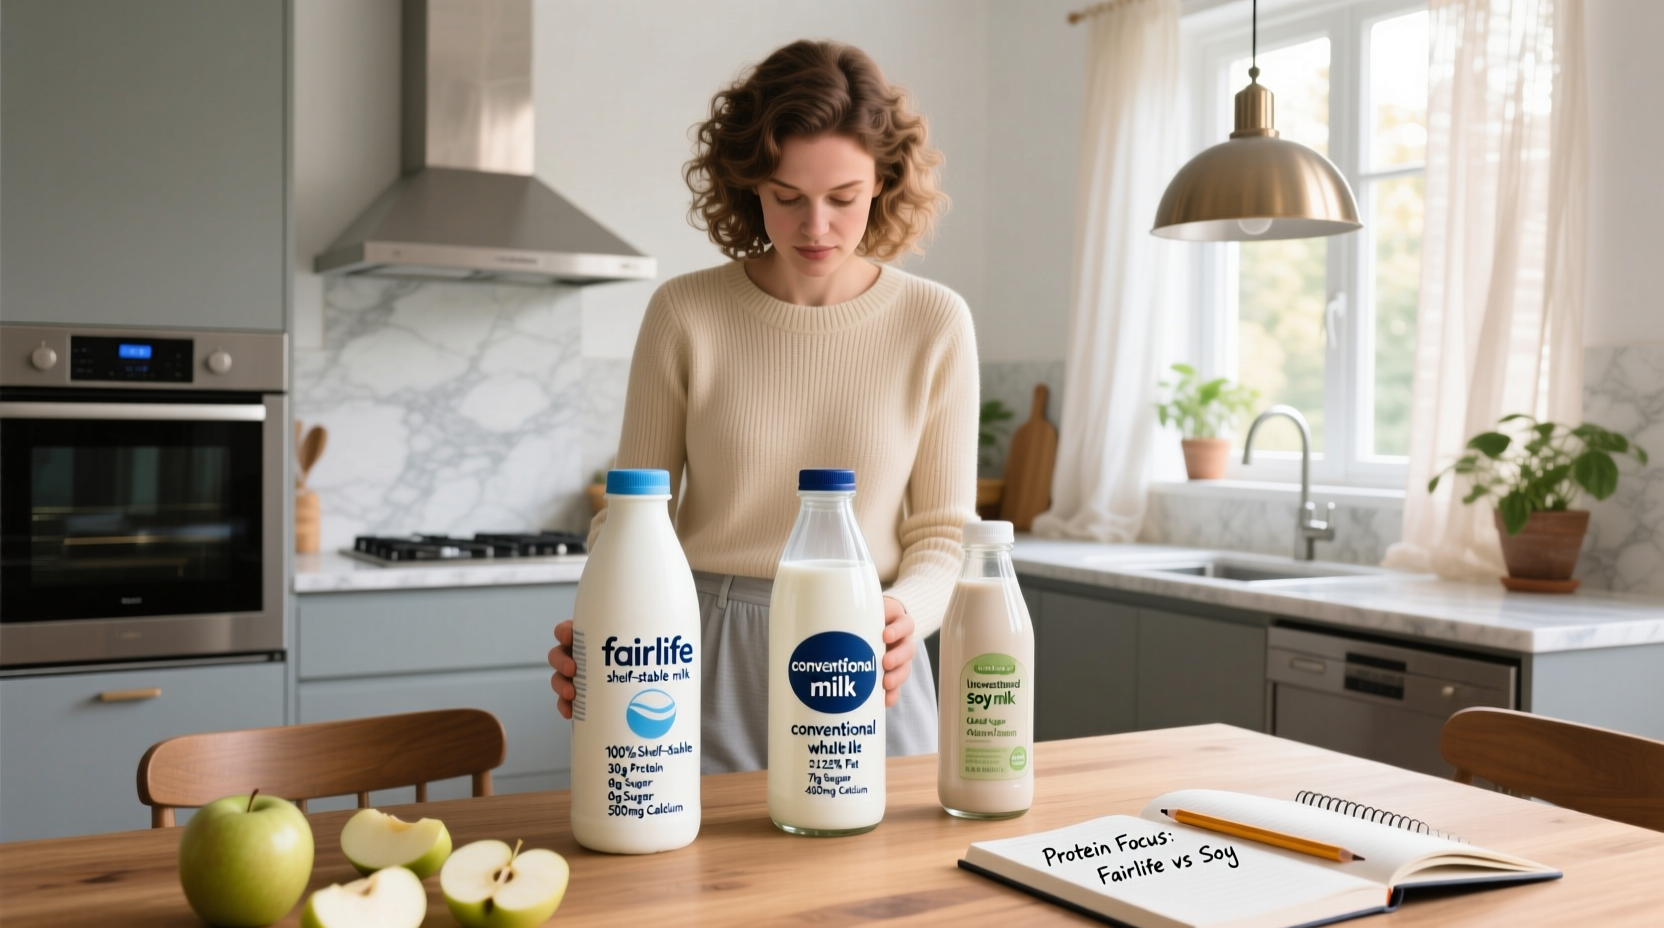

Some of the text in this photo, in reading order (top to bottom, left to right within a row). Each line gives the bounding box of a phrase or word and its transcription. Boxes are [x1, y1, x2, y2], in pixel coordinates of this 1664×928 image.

[602, 635, 693, 667] fairlife
[791, 655, 875, 673] conventional
[810, 675, 857, 697] milk
[791, 719, 876, 737] conventional
[605, 745, 637, 758] 100%
[607, 763, 628, 778] 30g
[623, 791, 655, 805] Sugar
[607, 804, 645, 819] 500mg
[1042, 831, 1175, 867] Protein Focus:
[1096, 844, 1240, 885] Fairlife vs Soy
